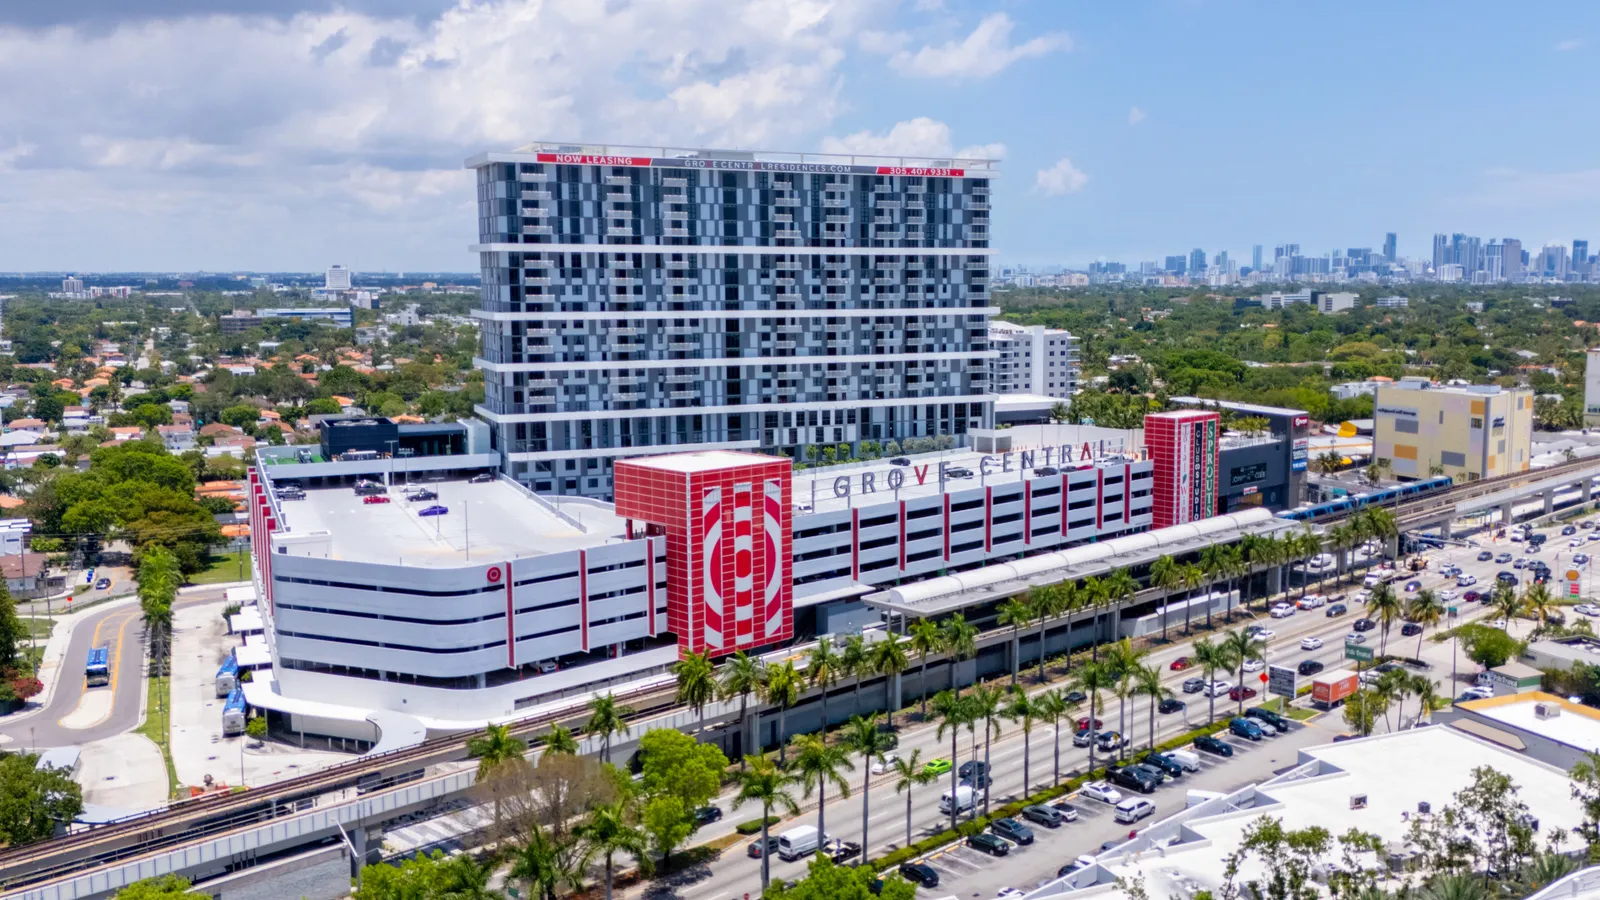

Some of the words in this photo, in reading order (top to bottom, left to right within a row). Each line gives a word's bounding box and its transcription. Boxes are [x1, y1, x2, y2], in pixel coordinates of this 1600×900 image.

[556, 154, 582, 164] NOW
[586, 156, 633, 166] LEASING
[889, 167, 951, 177] 305.407.9331
[833, 460, 951, 498] GROVE
[980, 439, 1110, 476] CENTRAL
[1206, 426, 1214, 517] SPROUTS
